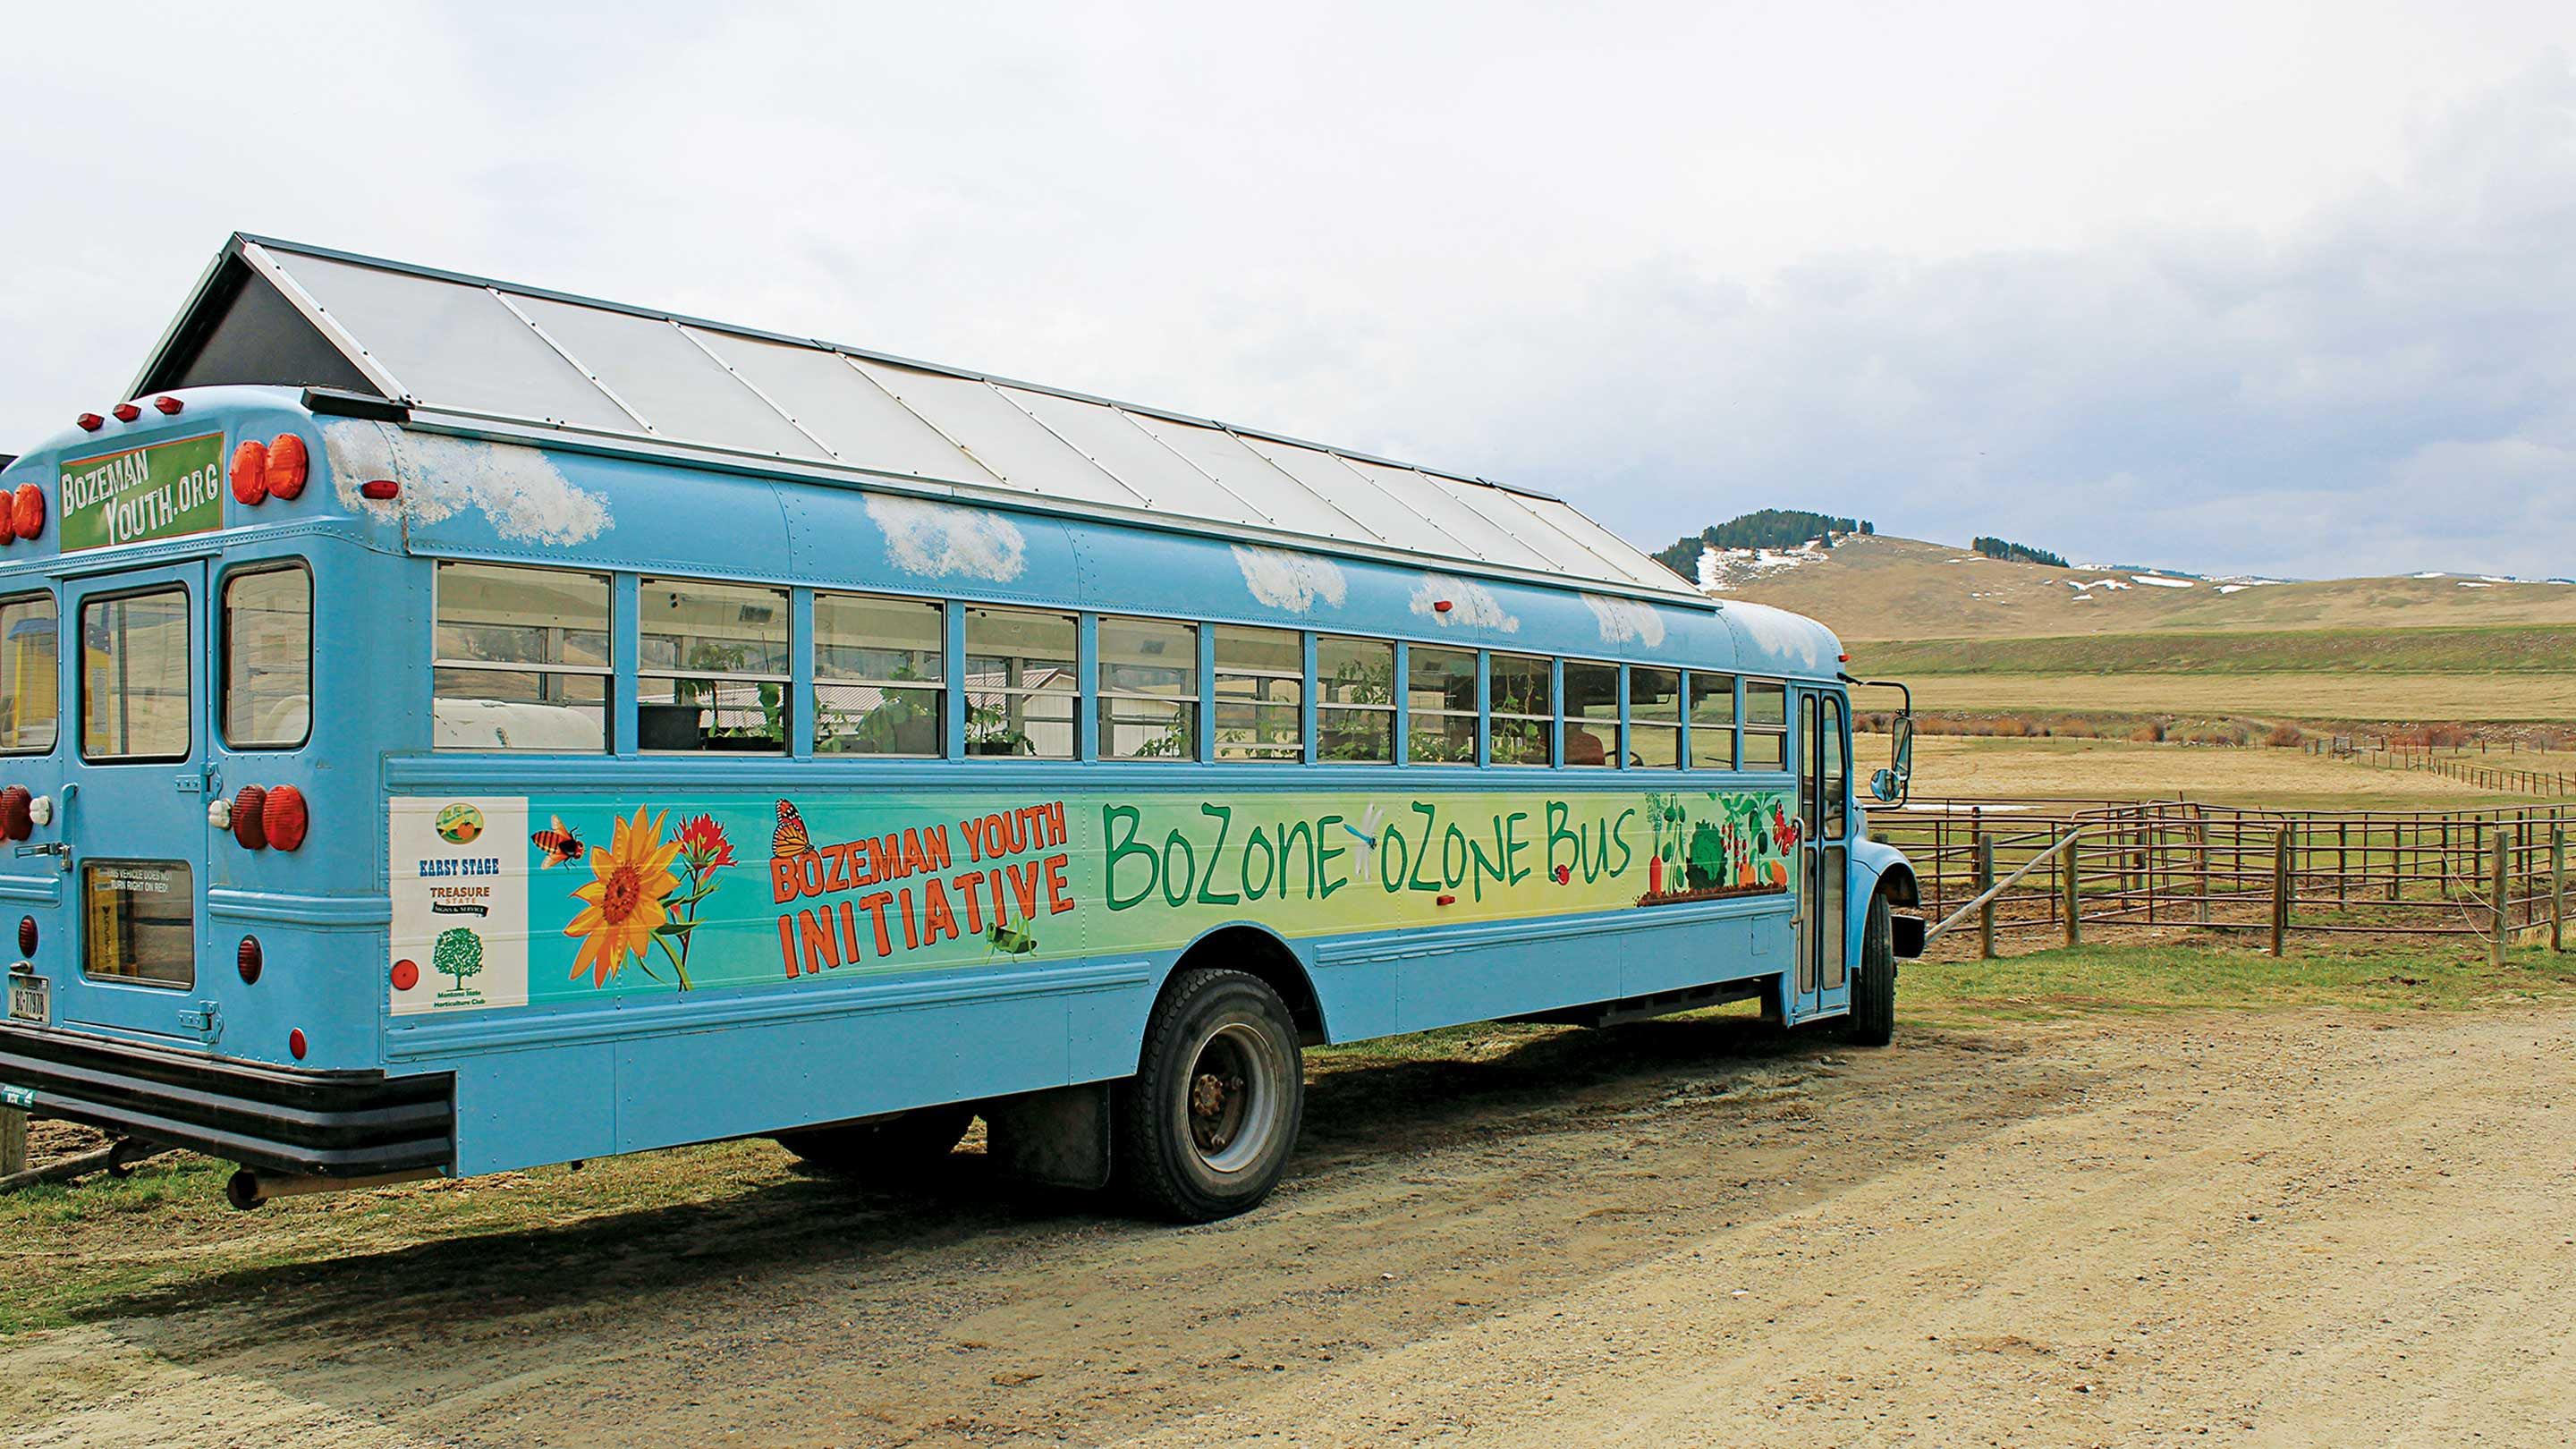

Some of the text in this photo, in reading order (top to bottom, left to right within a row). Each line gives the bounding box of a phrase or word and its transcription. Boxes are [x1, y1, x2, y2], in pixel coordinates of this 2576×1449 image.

[61, 449, 150, 518] BOZEMAN
[105, 462, 218, 546] YOUTH.ORG
[111, 880, 126, 890] TURN
[126, 880, 144, 891] RIGHT
[145, 881, 154, 892] ON
[419, 858, 499, 877] KARST STAGE
[770, 801, 1068, 904] BOZEMAN YOUTH
[430, 886, 490, 898] TREASURE
[778, 853, 1075, 979] INITIATIVE
